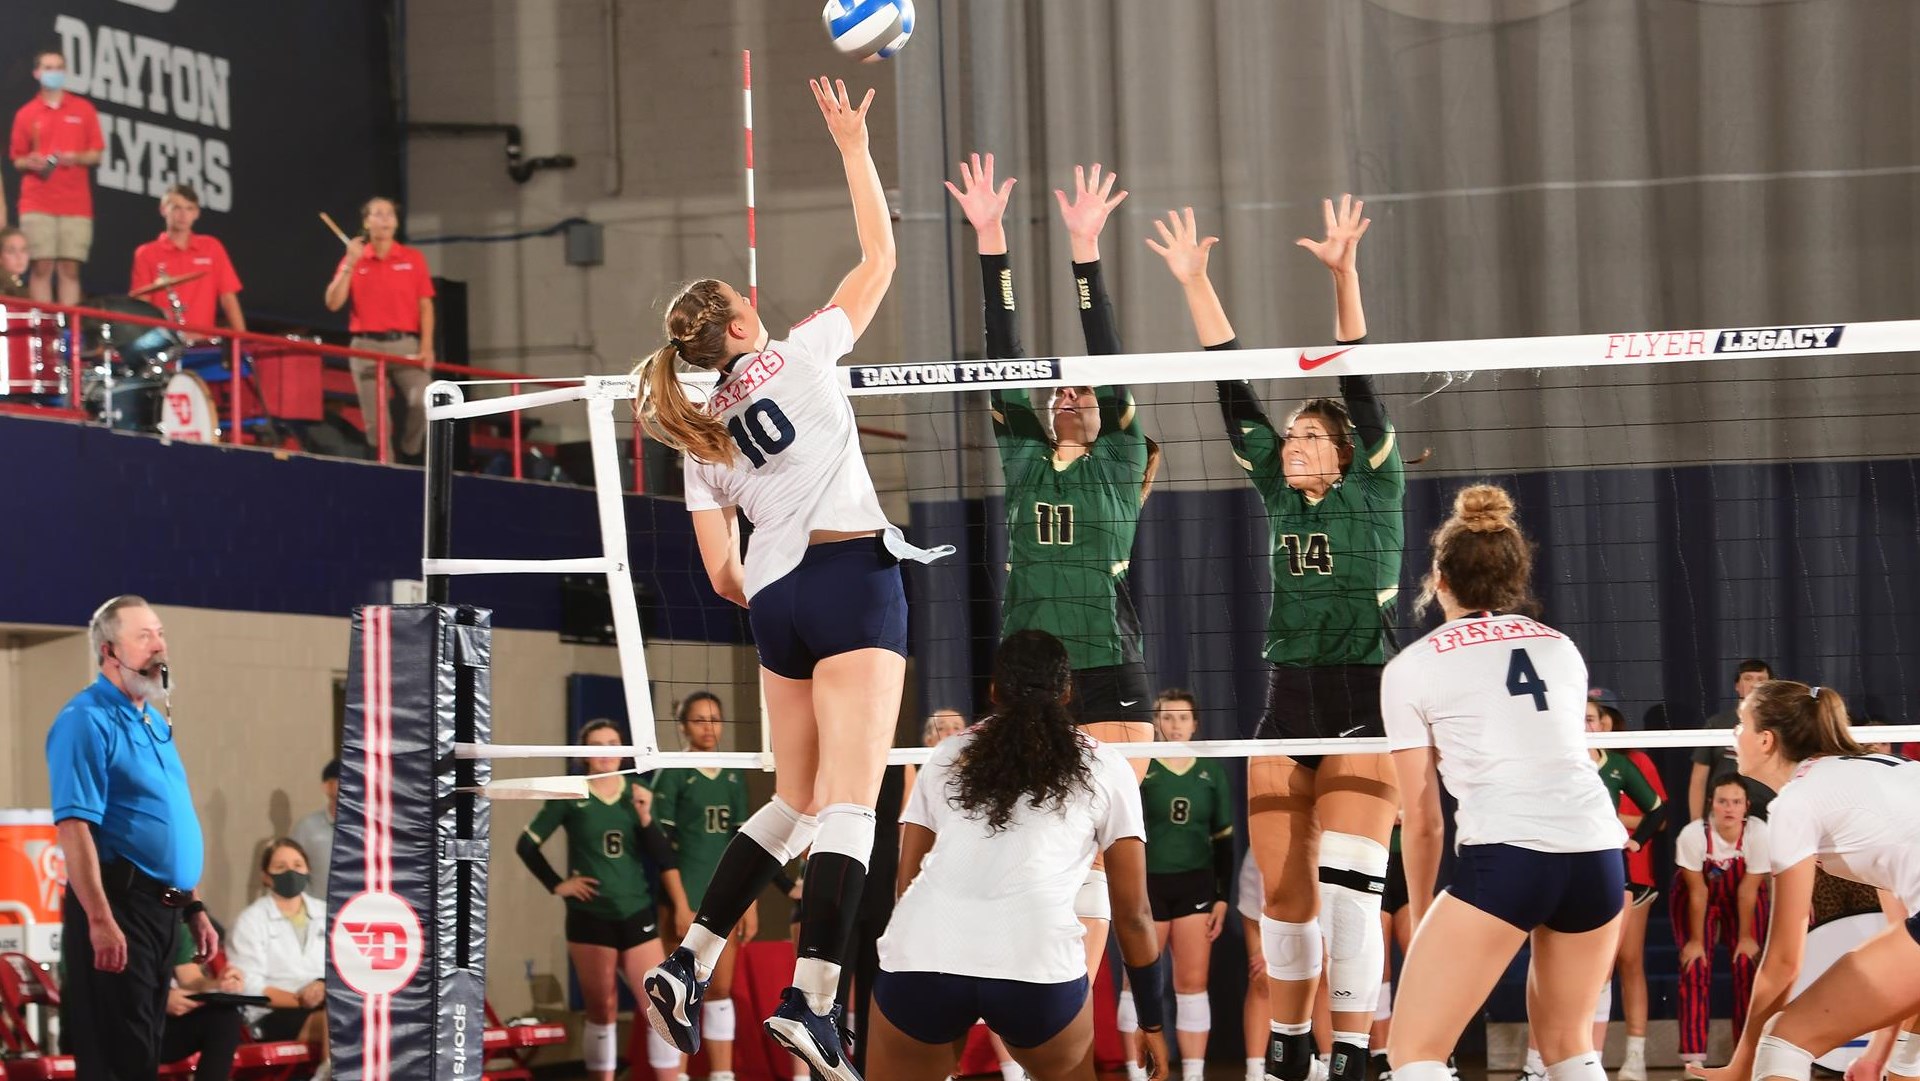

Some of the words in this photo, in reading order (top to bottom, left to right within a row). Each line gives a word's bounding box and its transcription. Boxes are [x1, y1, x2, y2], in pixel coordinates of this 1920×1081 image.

[55, 14, 231, 131] DAYTON
[96, 111, 232, 213] LYERS
[1000, 268, 1015, 312] WRIGHT
[1077, 277, 1092, 310] STATE
[1605, 331, 1705, 359] FLYER
[1721, 327, 1835, 352] LEGACY
[709, 349, 785, 418] LYERS
[860, 363, 956, 387] DAYTON
[959, 360, 1053, 382] FLYERS
[727, 398, 796, 469] 10
[1036, 502, 1074, 545] 11
[1281, 533, 1333, 576] 14
[1506, 648, 1549, 712] 4
[704, 804, 731, 834] 16
[1170, 796, 1191, 825] 8
[603, 829, 624, 859] 6
[453, 1003, 467, 1075] sports
